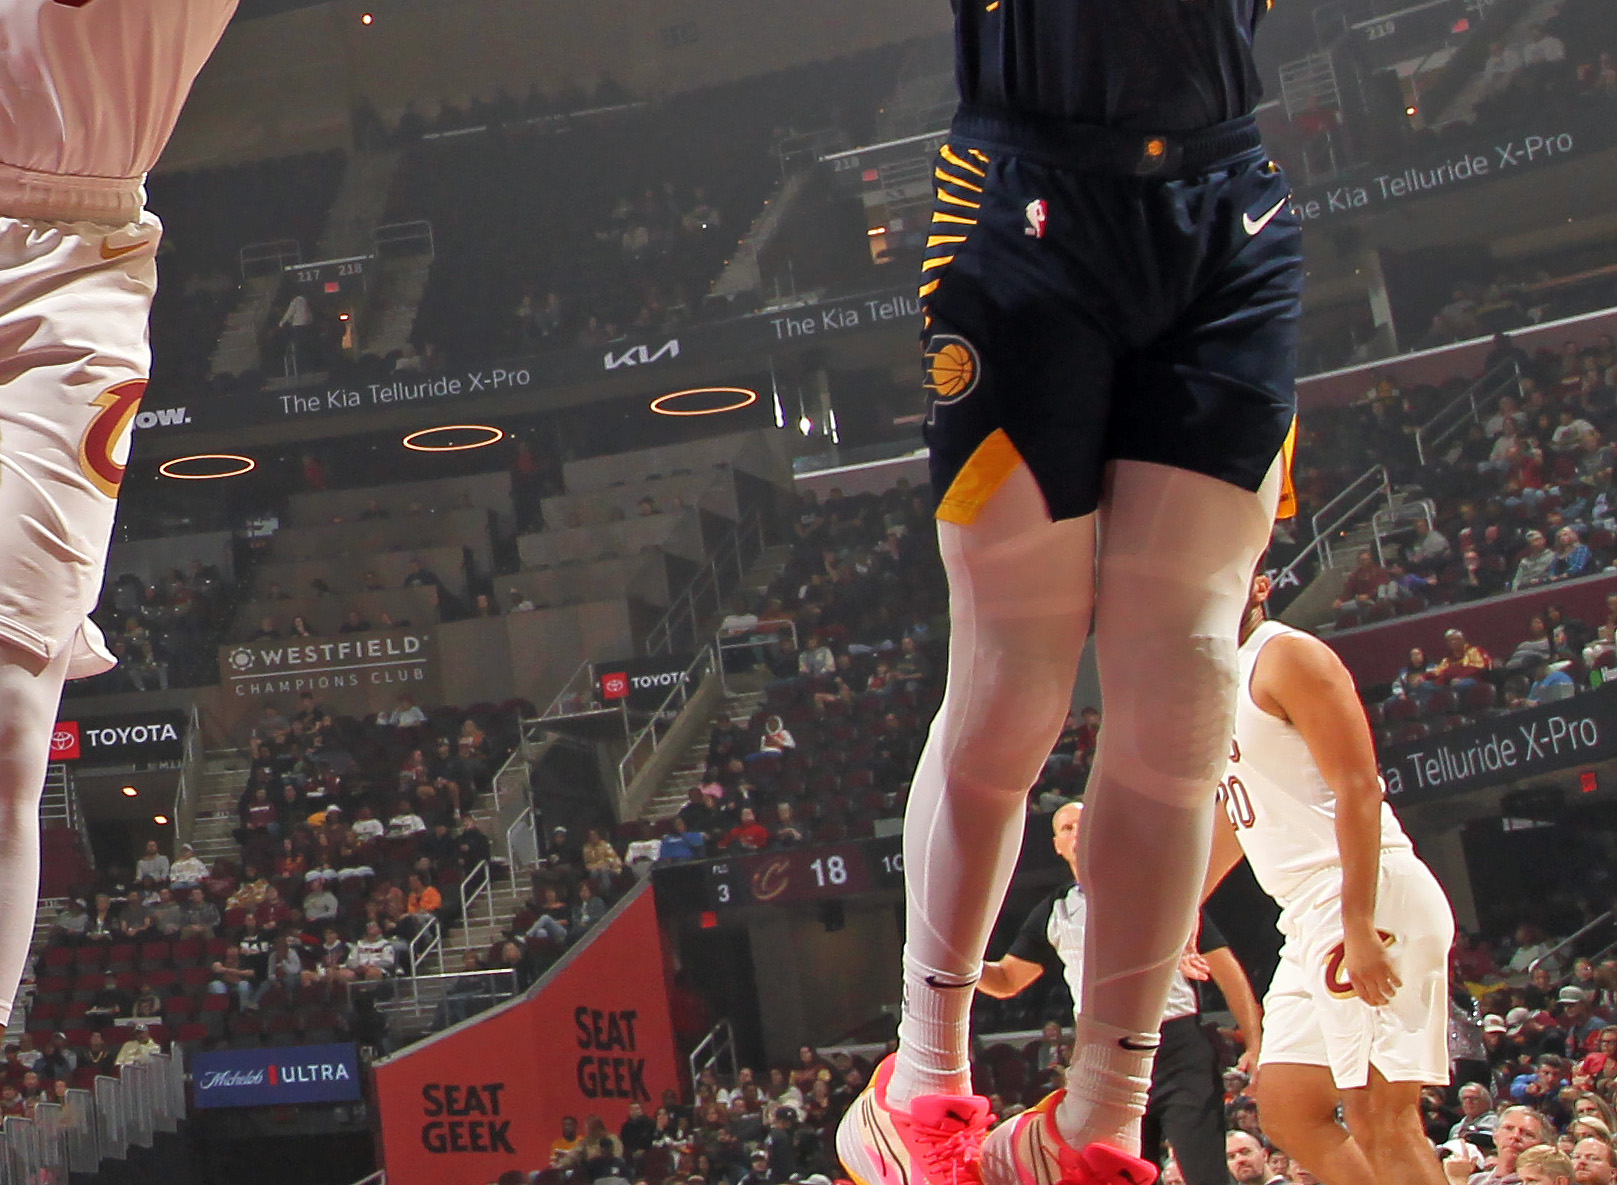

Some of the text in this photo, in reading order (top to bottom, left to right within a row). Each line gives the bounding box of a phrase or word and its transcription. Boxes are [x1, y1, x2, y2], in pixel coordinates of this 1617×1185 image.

[1326, 187, 1368, 213] Kia
[1374, 154, 1488, 201] Telluride
[1495, 132, 1573, 170] X-Pro
[297, 269, 320, 282] 217
[770, 317, 816, 341] The
[822, 307, 859, 331] Kia
[279, 368, 531, 415] The Kia Telluride X-Pro
[260, 636, 421, 666] WESTFIELD
[234, 668, 424, 697] CHAMPIONS CLUB
[86, 723, 178, 747] TOYOTA
[1406, 733, 1517, 789] Telluride
[1519, 715, 1598, 762] X-Pro
[717, 884, 730, 903] 3
[809, 855, 848, 887] 18
[574, 1006, 638, 1052] SEAT
[199, 1063, 350, 1090] Michelob ULTRA
[576, 1055, 652, 1103] GEEK
[422, 1082, 505, 1117] SEAT
[422, 1120, 516, 1154] GEEK
